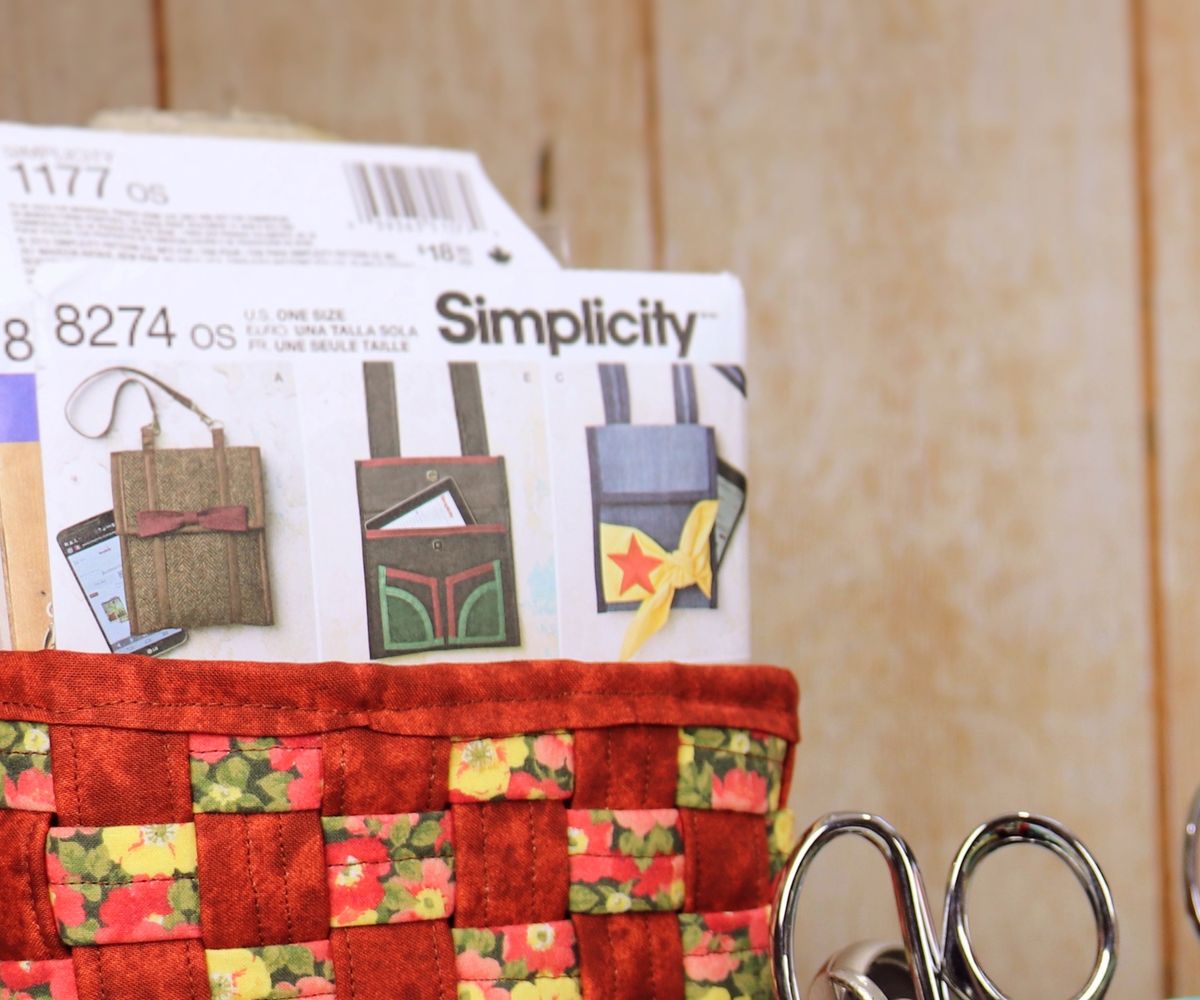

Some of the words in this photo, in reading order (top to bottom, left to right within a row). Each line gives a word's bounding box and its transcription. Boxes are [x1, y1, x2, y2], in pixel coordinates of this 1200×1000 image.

[10, 162, 110, 198] 1177
[126, 182, 169, 205] OS
[55, 303, 176, 347] 8274
[190, 323, 237, 350] OS
[276, 309, 308, 322] ONE
[312, 309, 347, 322] SIZE
[295, 324, 327, 337] UNA
[330, 324, 377, 337] TALLA
[380, 324, 418, 337] SOLA
[434, 291, 697, 358] Simplicity
[4, 318, 34, 362] 8
[275, 340, 307, 353] UNE
[311, 340, 358, 353] SEULE
[363, 339, 410, 353] TAILLE
